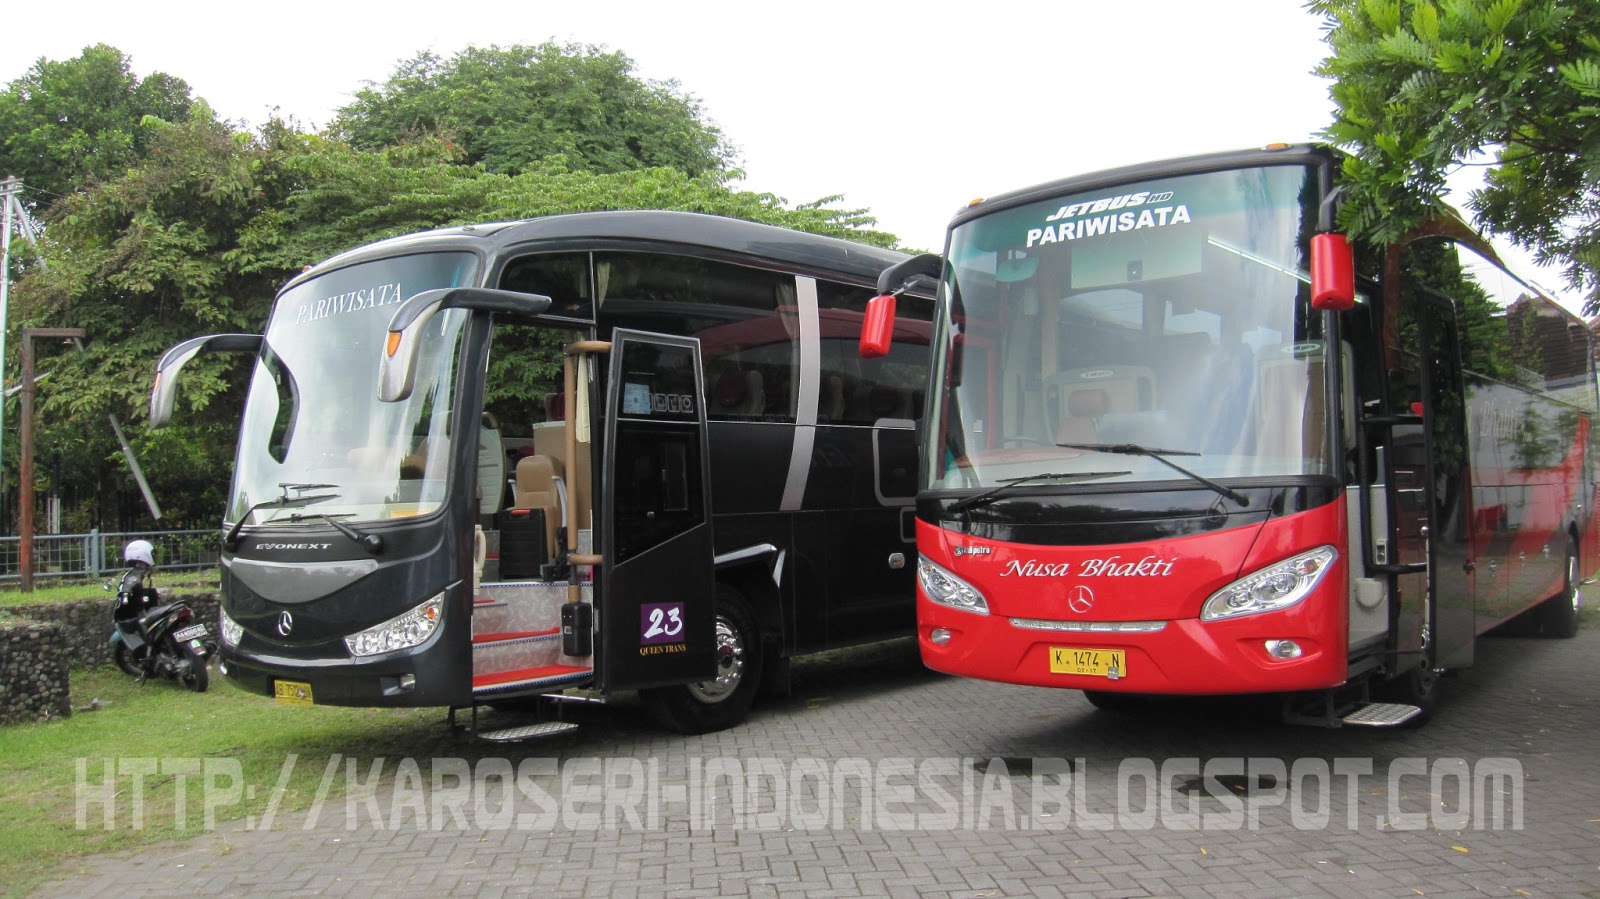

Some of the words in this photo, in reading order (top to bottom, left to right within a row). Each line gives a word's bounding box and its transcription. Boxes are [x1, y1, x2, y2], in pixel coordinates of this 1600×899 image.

[1046, 192, 1150, 221] JETBUS
[1148, 192, 1173, 204] HD
[1026, 205, 1191, 248] PARIWISATA
[296, 282, 402, 325] PARIWISATA
[1000, 560, 1069, 577] Nusa
[1078, 556, 1176, 577] Bhakti
[644, 607, 683, 639] 23
[639, 646, 664, 656] QUEEN
[665, 645, 686, 653] TRANS
[1074, 652, 1099, 667] 1474
